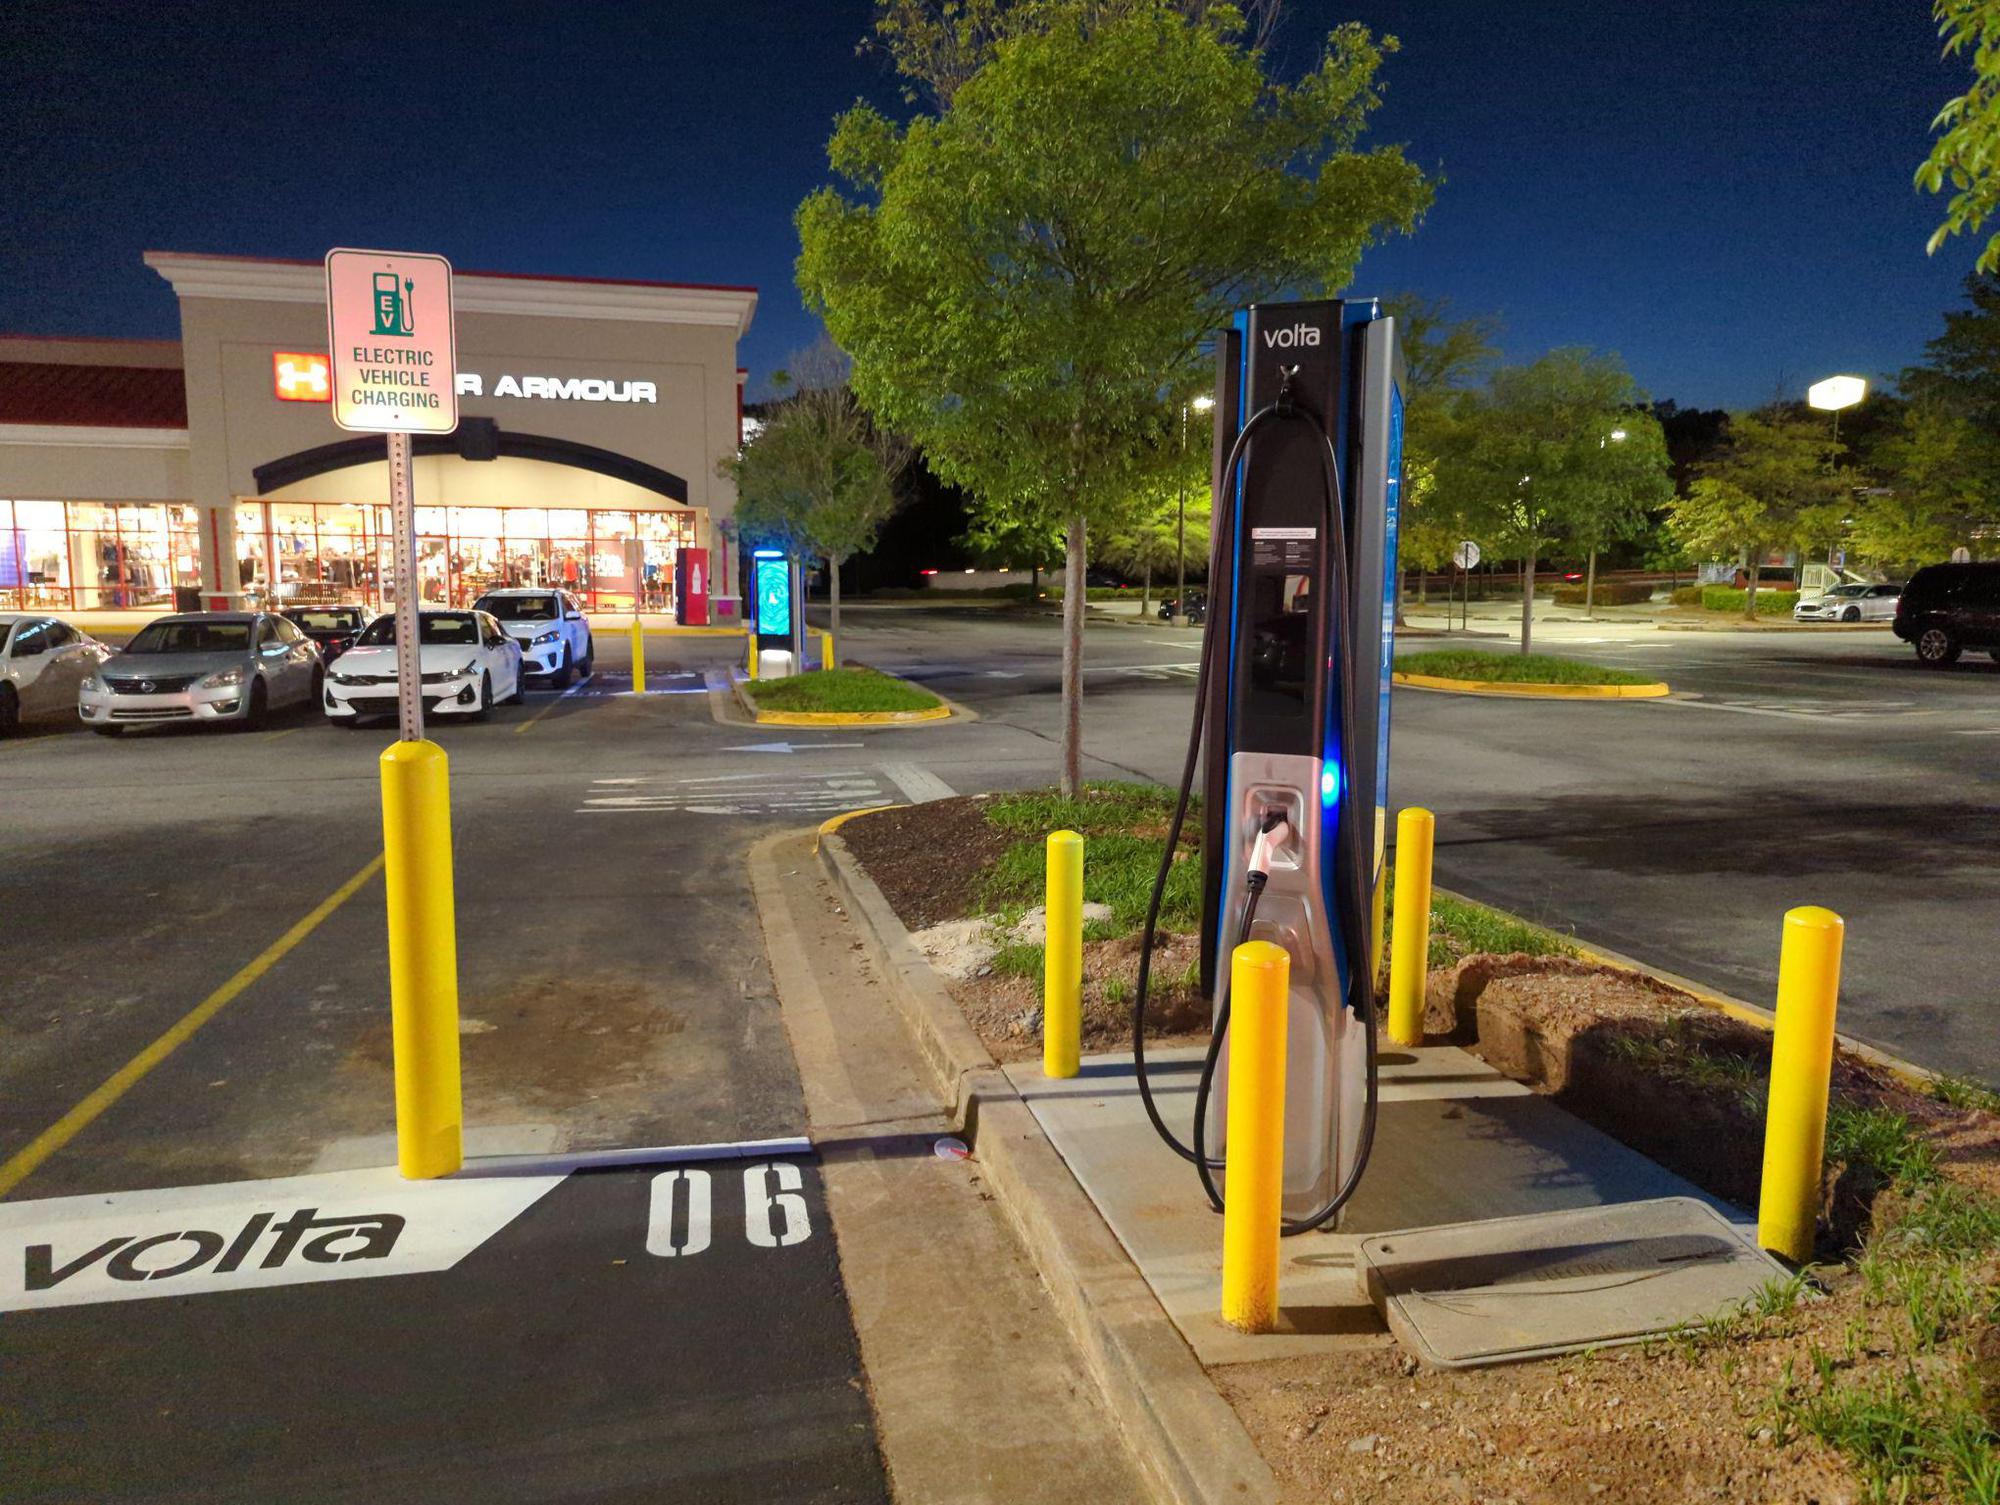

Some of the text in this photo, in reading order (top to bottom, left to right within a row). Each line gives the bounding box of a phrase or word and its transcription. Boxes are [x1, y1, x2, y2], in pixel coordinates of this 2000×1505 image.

[1263, 323, 1321, 348] volta
[353, 347, 433, 366] ELECTRIC
[359, 368, 430, 387] VEHICLE
[494, 375, 657, 403] ARMOUR
[352, 389, 439, 408] CHARGING
[646, 1161, 812, 1257] 06
[25, 1208, 406, 1291] volta
